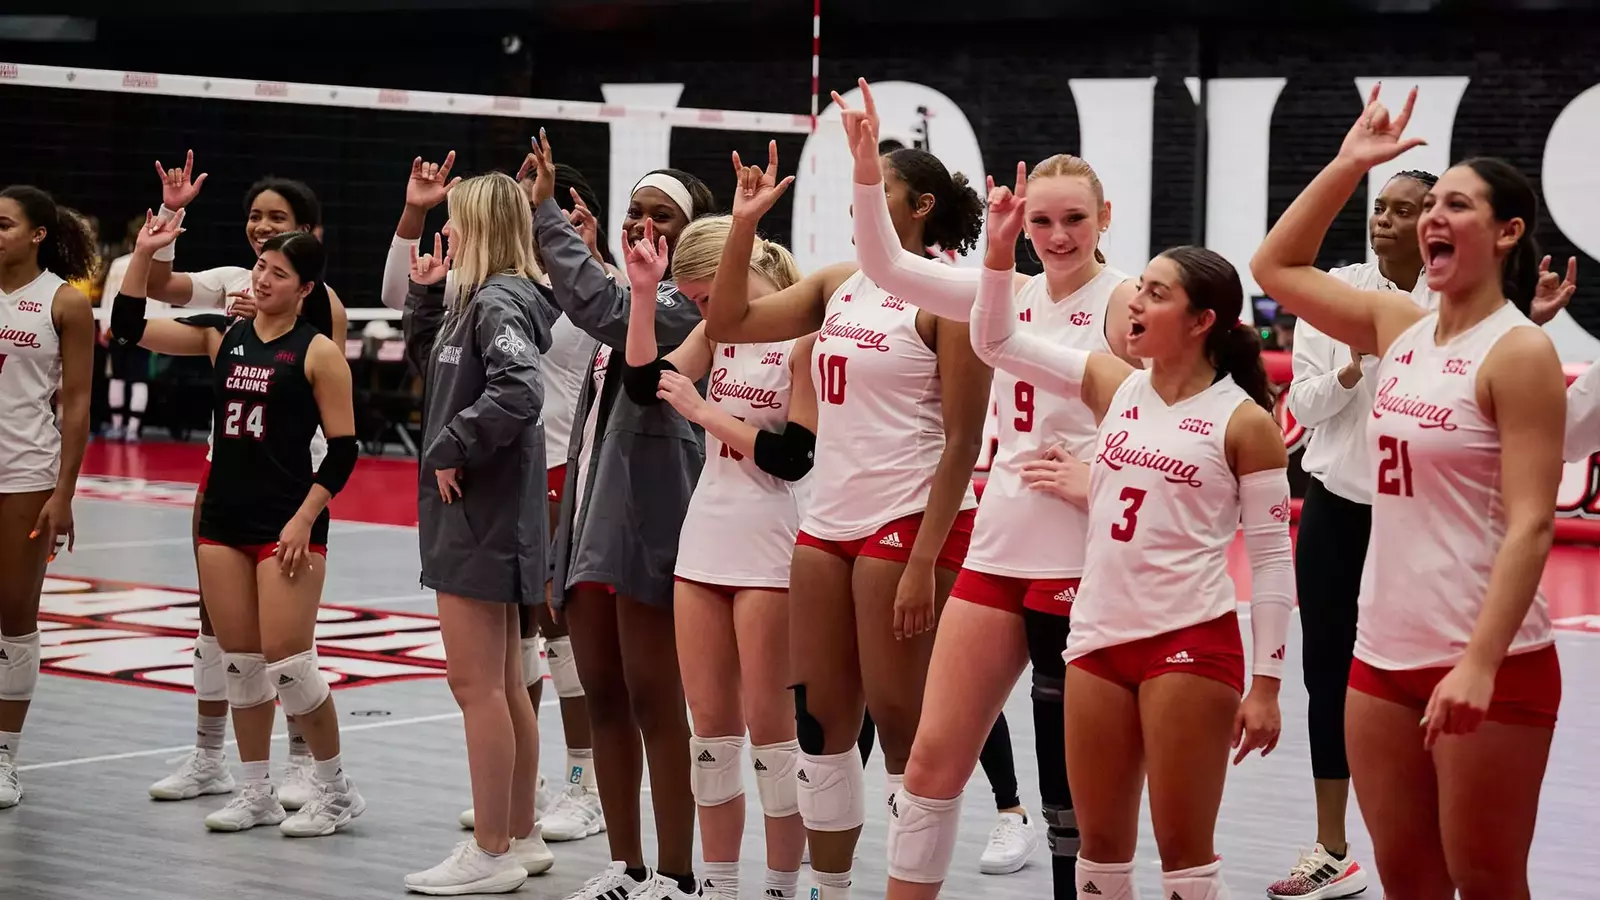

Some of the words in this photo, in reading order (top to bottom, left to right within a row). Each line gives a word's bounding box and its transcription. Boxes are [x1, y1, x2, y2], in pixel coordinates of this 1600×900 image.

[226, 377, 268, 393] CAJUNS
[818, 353, 848, 405] 10
[224, 401, 266, 440] 24
[1013, 381, 1035, 432] 9
[1096, 430, 1202, 488] Louisiana
[1377, 435, 1414, 498] 21
[1110, 486, 1148, 543] 3
